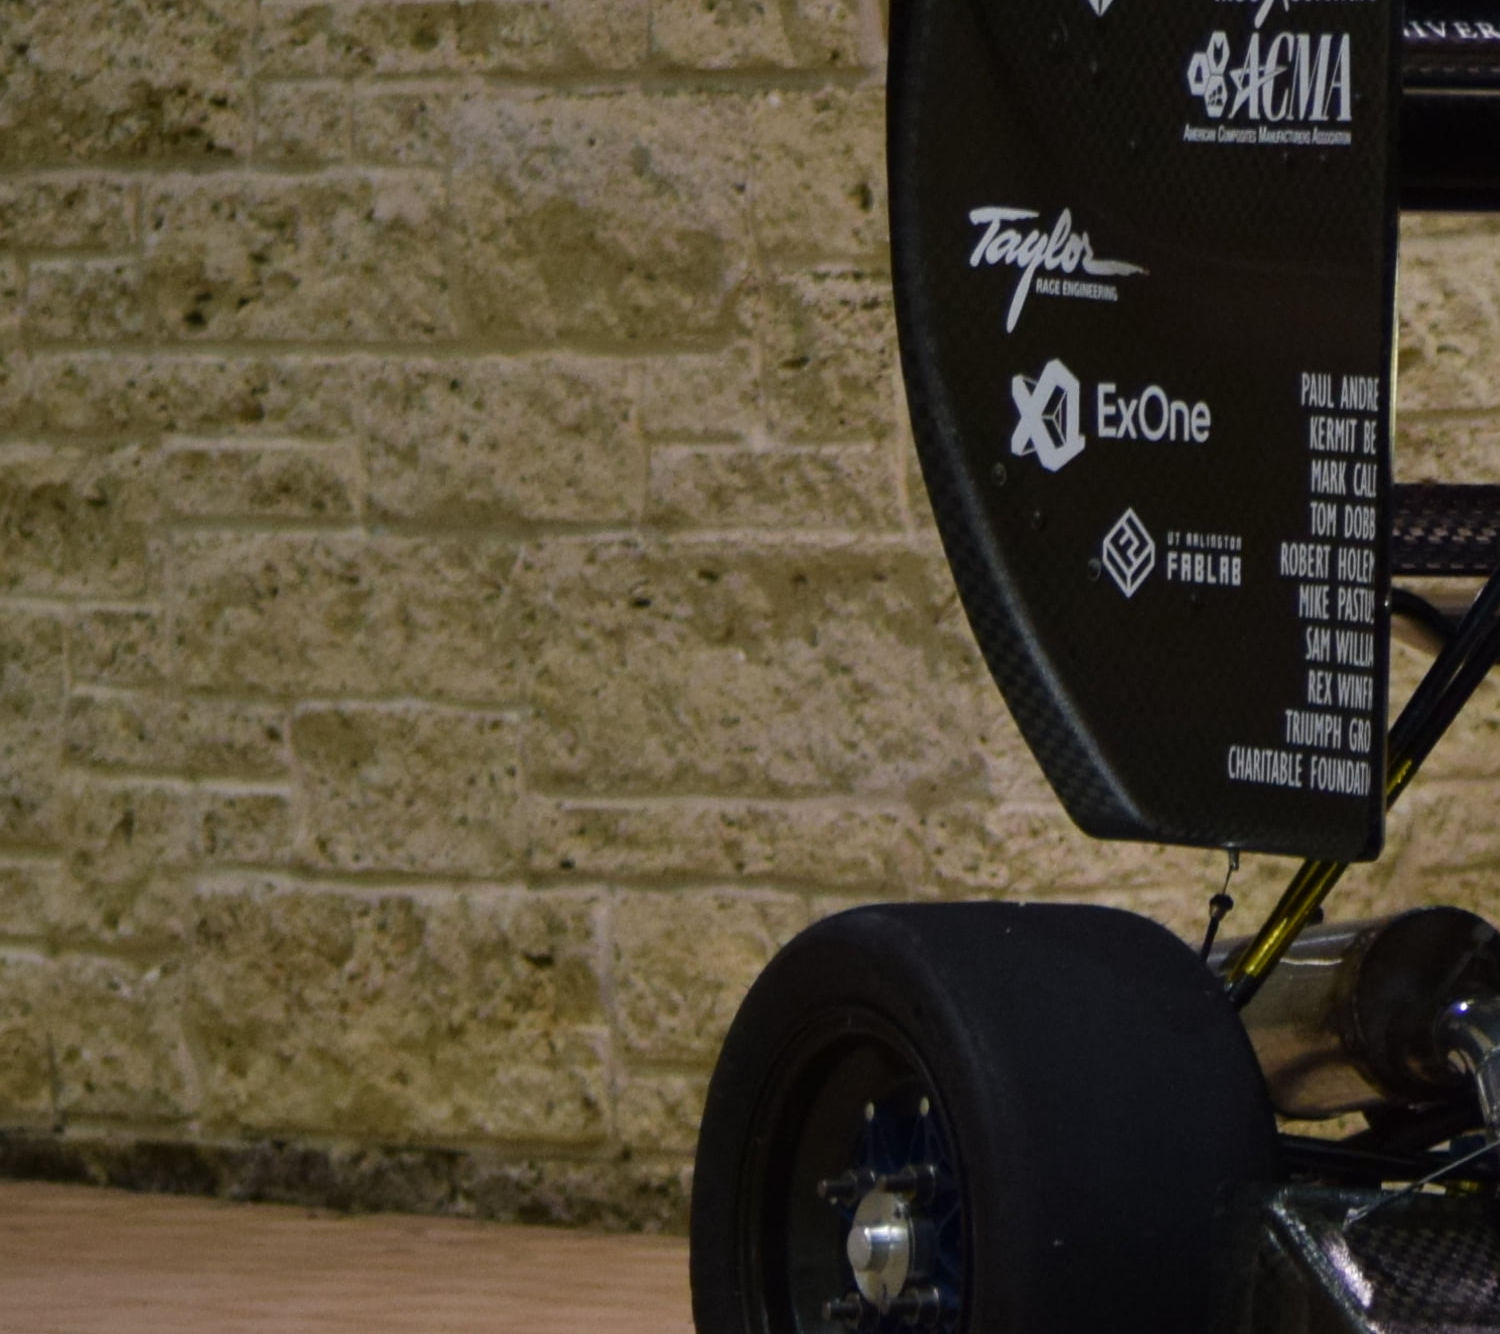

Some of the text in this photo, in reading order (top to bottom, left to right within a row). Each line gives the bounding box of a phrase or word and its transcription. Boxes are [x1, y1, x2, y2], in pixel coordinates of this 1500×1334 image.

[969, 206, 1149, 334] Taylor
[1301, 372, 1335, 408] PAUL
[1097, 383, 1211, 443] ExOne
[1309, 415, 1358, 453] KERMIT
[1311, 459, 1347, 495] MARK
[1310, 502, 1337, 537] TOM
[1280, 542, 1331, 579] ROBERT
[1299, 584, 1330, 620] MIKE
[1305, 626, 1330, 662] SAM
[1308, 669, 1332, 706] REX
[1285, 709, 1342, 750] TRIUMPH
[1228, 745, 1303, 788] CHARITABLE
